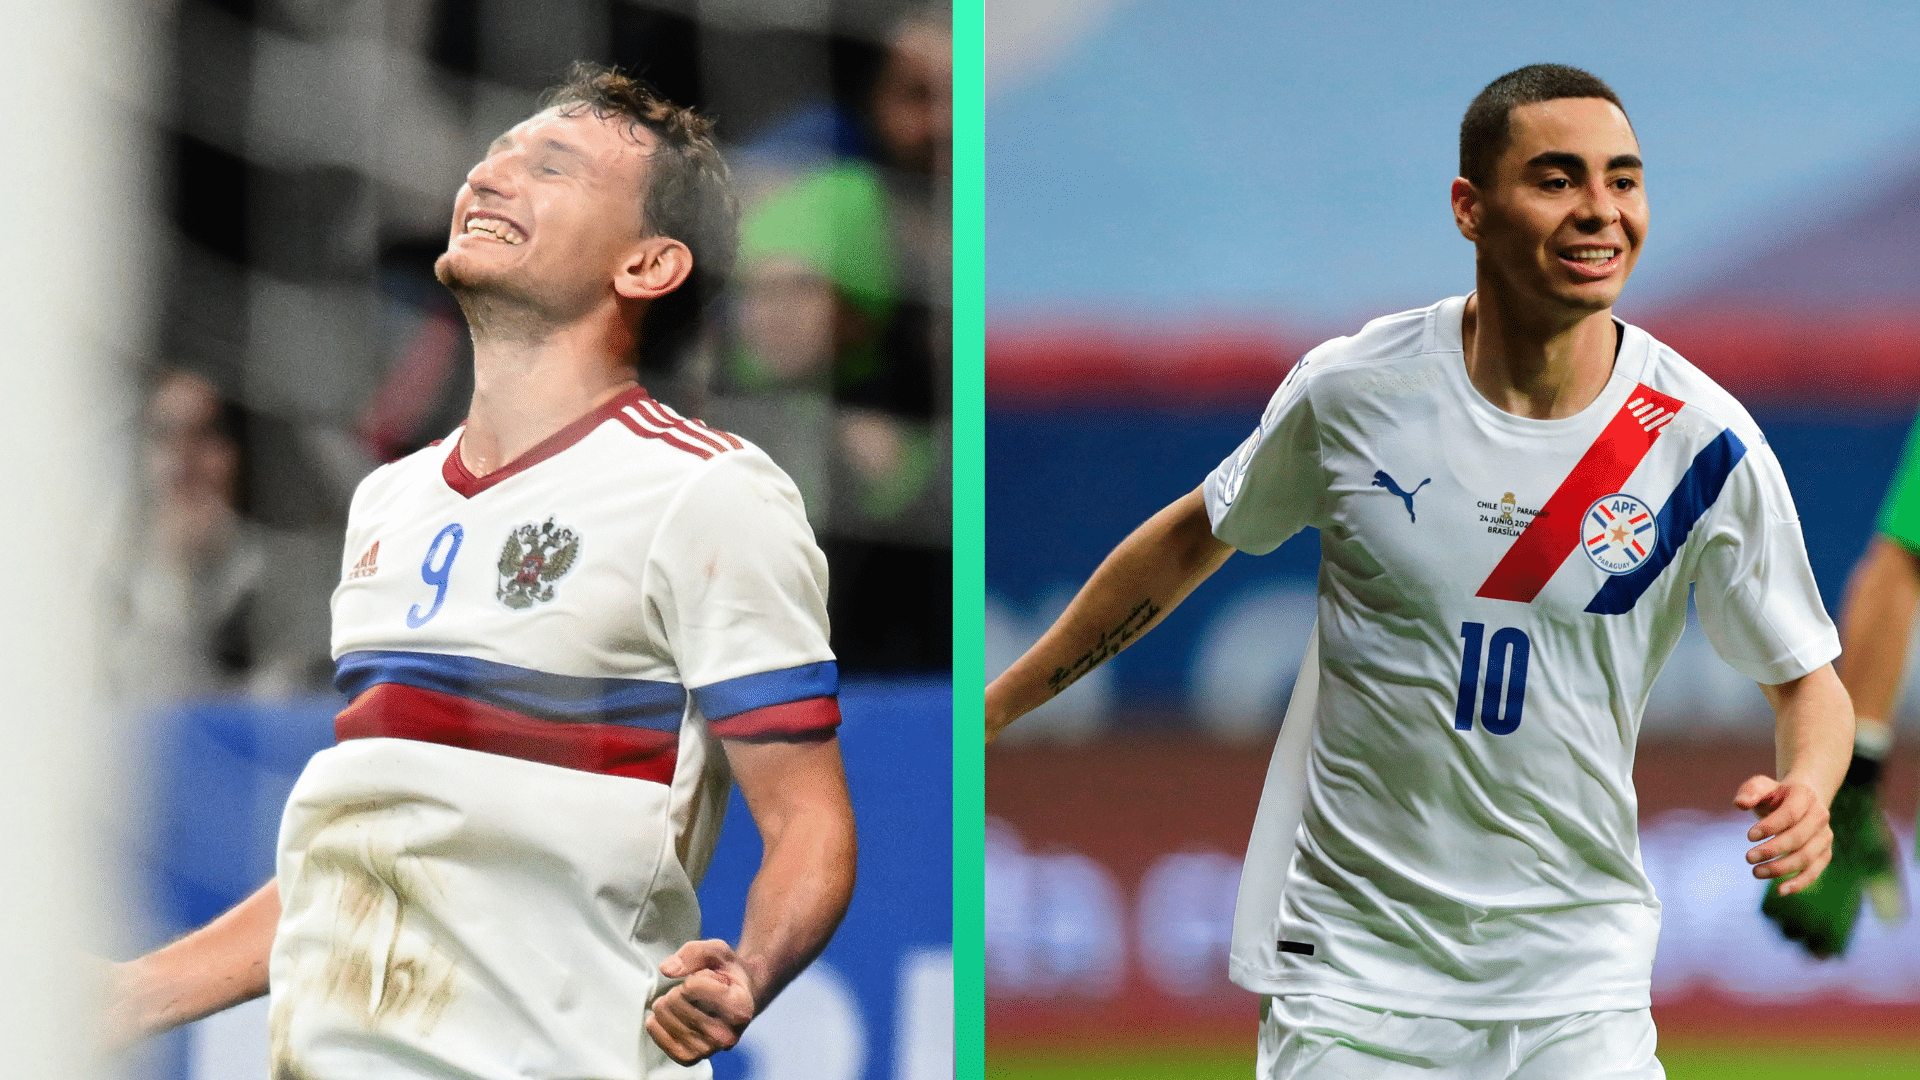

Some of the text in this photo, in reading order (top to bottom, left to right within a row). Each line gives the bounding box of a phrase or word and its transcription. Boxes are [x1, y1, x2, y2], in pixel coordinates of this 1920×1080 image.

[1477, 501, 1497, 510] CHILE
[1611, 500, 1637, 515] APF
[1490, 517, 1514, 526] JUNIO
[1487, 526, 1521, 537] BRASÍLIA
[1597, 556, 1631, 570] PARAGUAY
[406, 523, 464, 629] 9
[1455, 622, 1530, 735] 10
